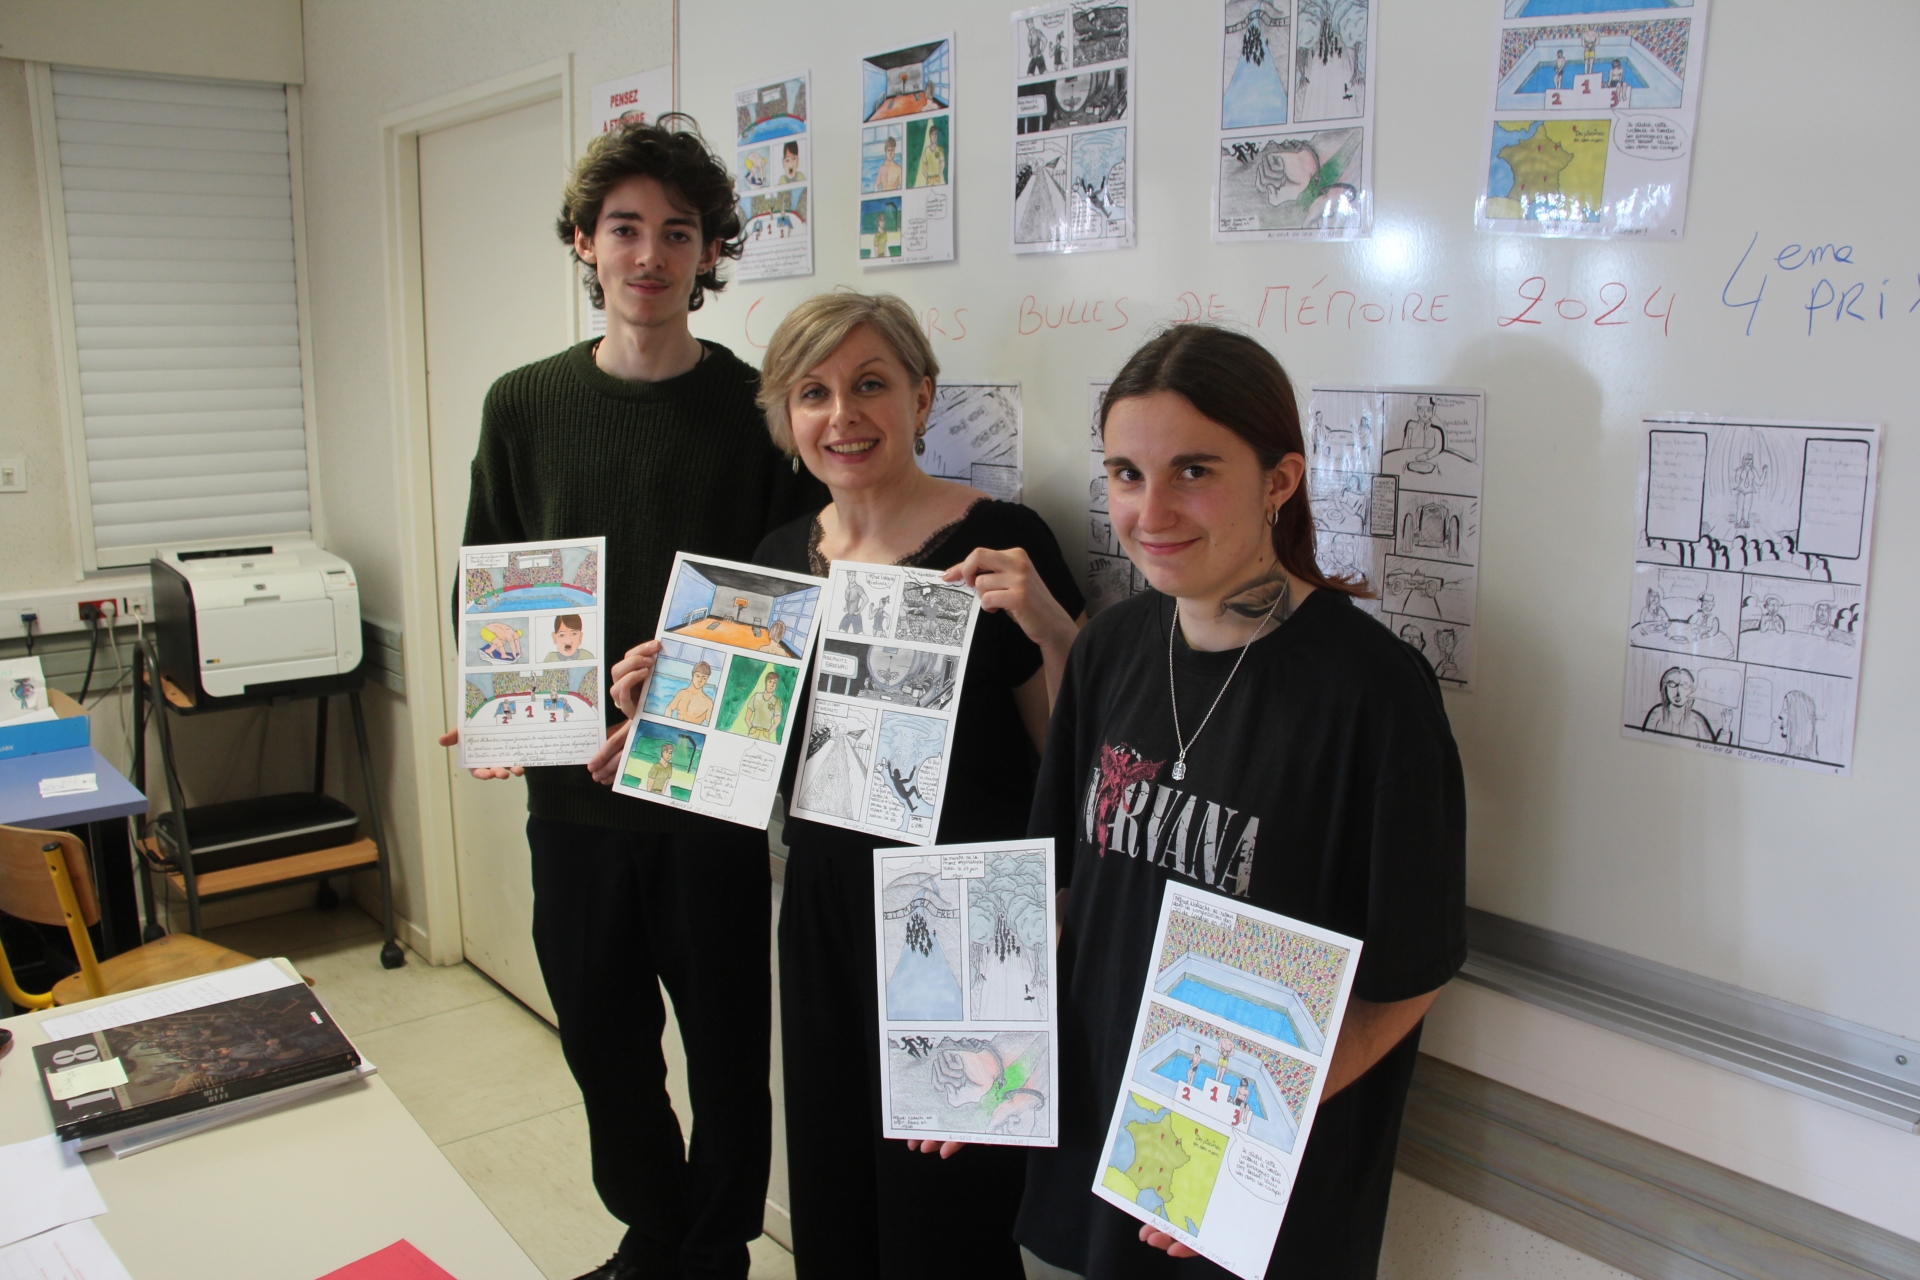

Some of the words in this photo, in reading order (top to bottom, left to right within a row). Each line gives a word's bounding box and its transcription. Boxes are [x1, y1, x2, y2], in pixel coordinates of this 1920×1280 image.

[1581, 79, 1592, 95] 1
[610, 88, 639, 109] PENSEZ
[1551, 92, 1562, 106] 2
[1610, 91, 1620, 109] 3
[1018, 294, 1130, 336] BULLES
[1174, 291, 1227, 324] DE
[1496, 275, 1677, 338] 2024
[502, 715, 509, 725] 2
[549, 712, 557, 723] 3
[525, 705, 534, 718] 1
[1210, 1086, 1219, 1102] 1
[1182, 1086, 1191, 1102] 2
[1231, 1108, 1240, 1127] 3
